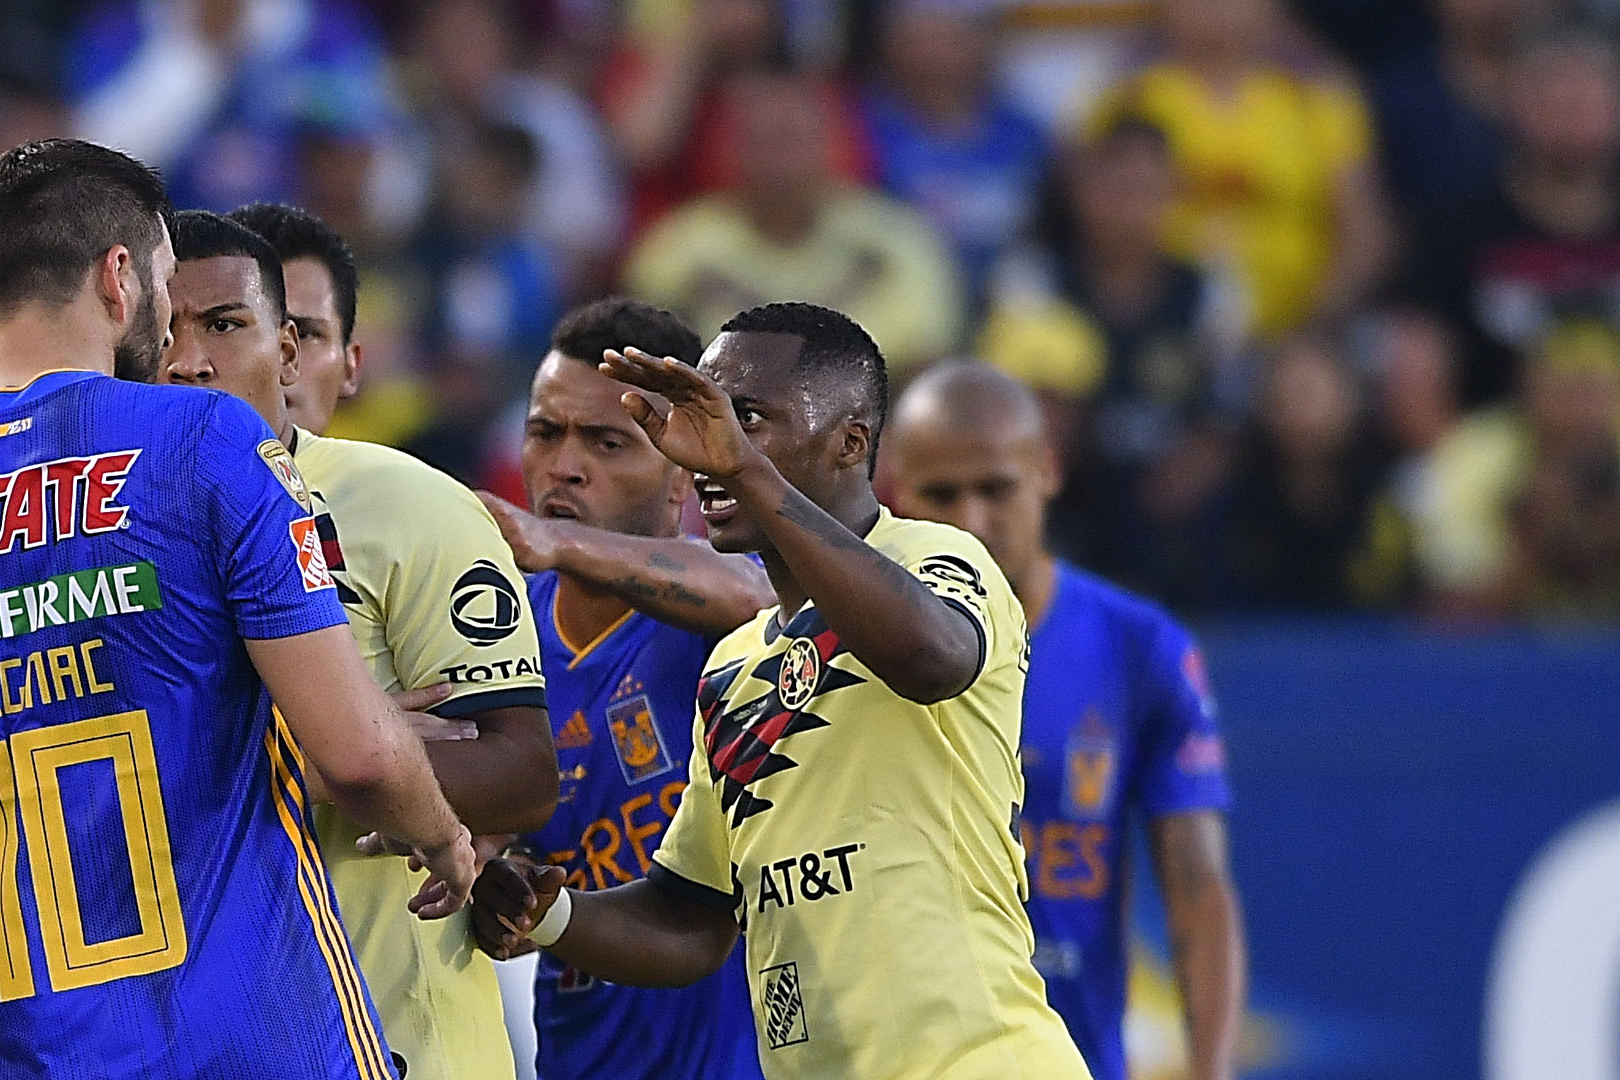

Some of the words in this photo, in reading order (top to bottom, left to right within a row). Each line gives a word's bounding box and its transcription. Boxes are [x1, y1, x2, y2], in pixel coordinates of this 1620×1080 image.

[439, 656, 541, 684] TOTAL
[758, 844, 859, 914] AT&T
[766, 967, 798, 1047] HOME
